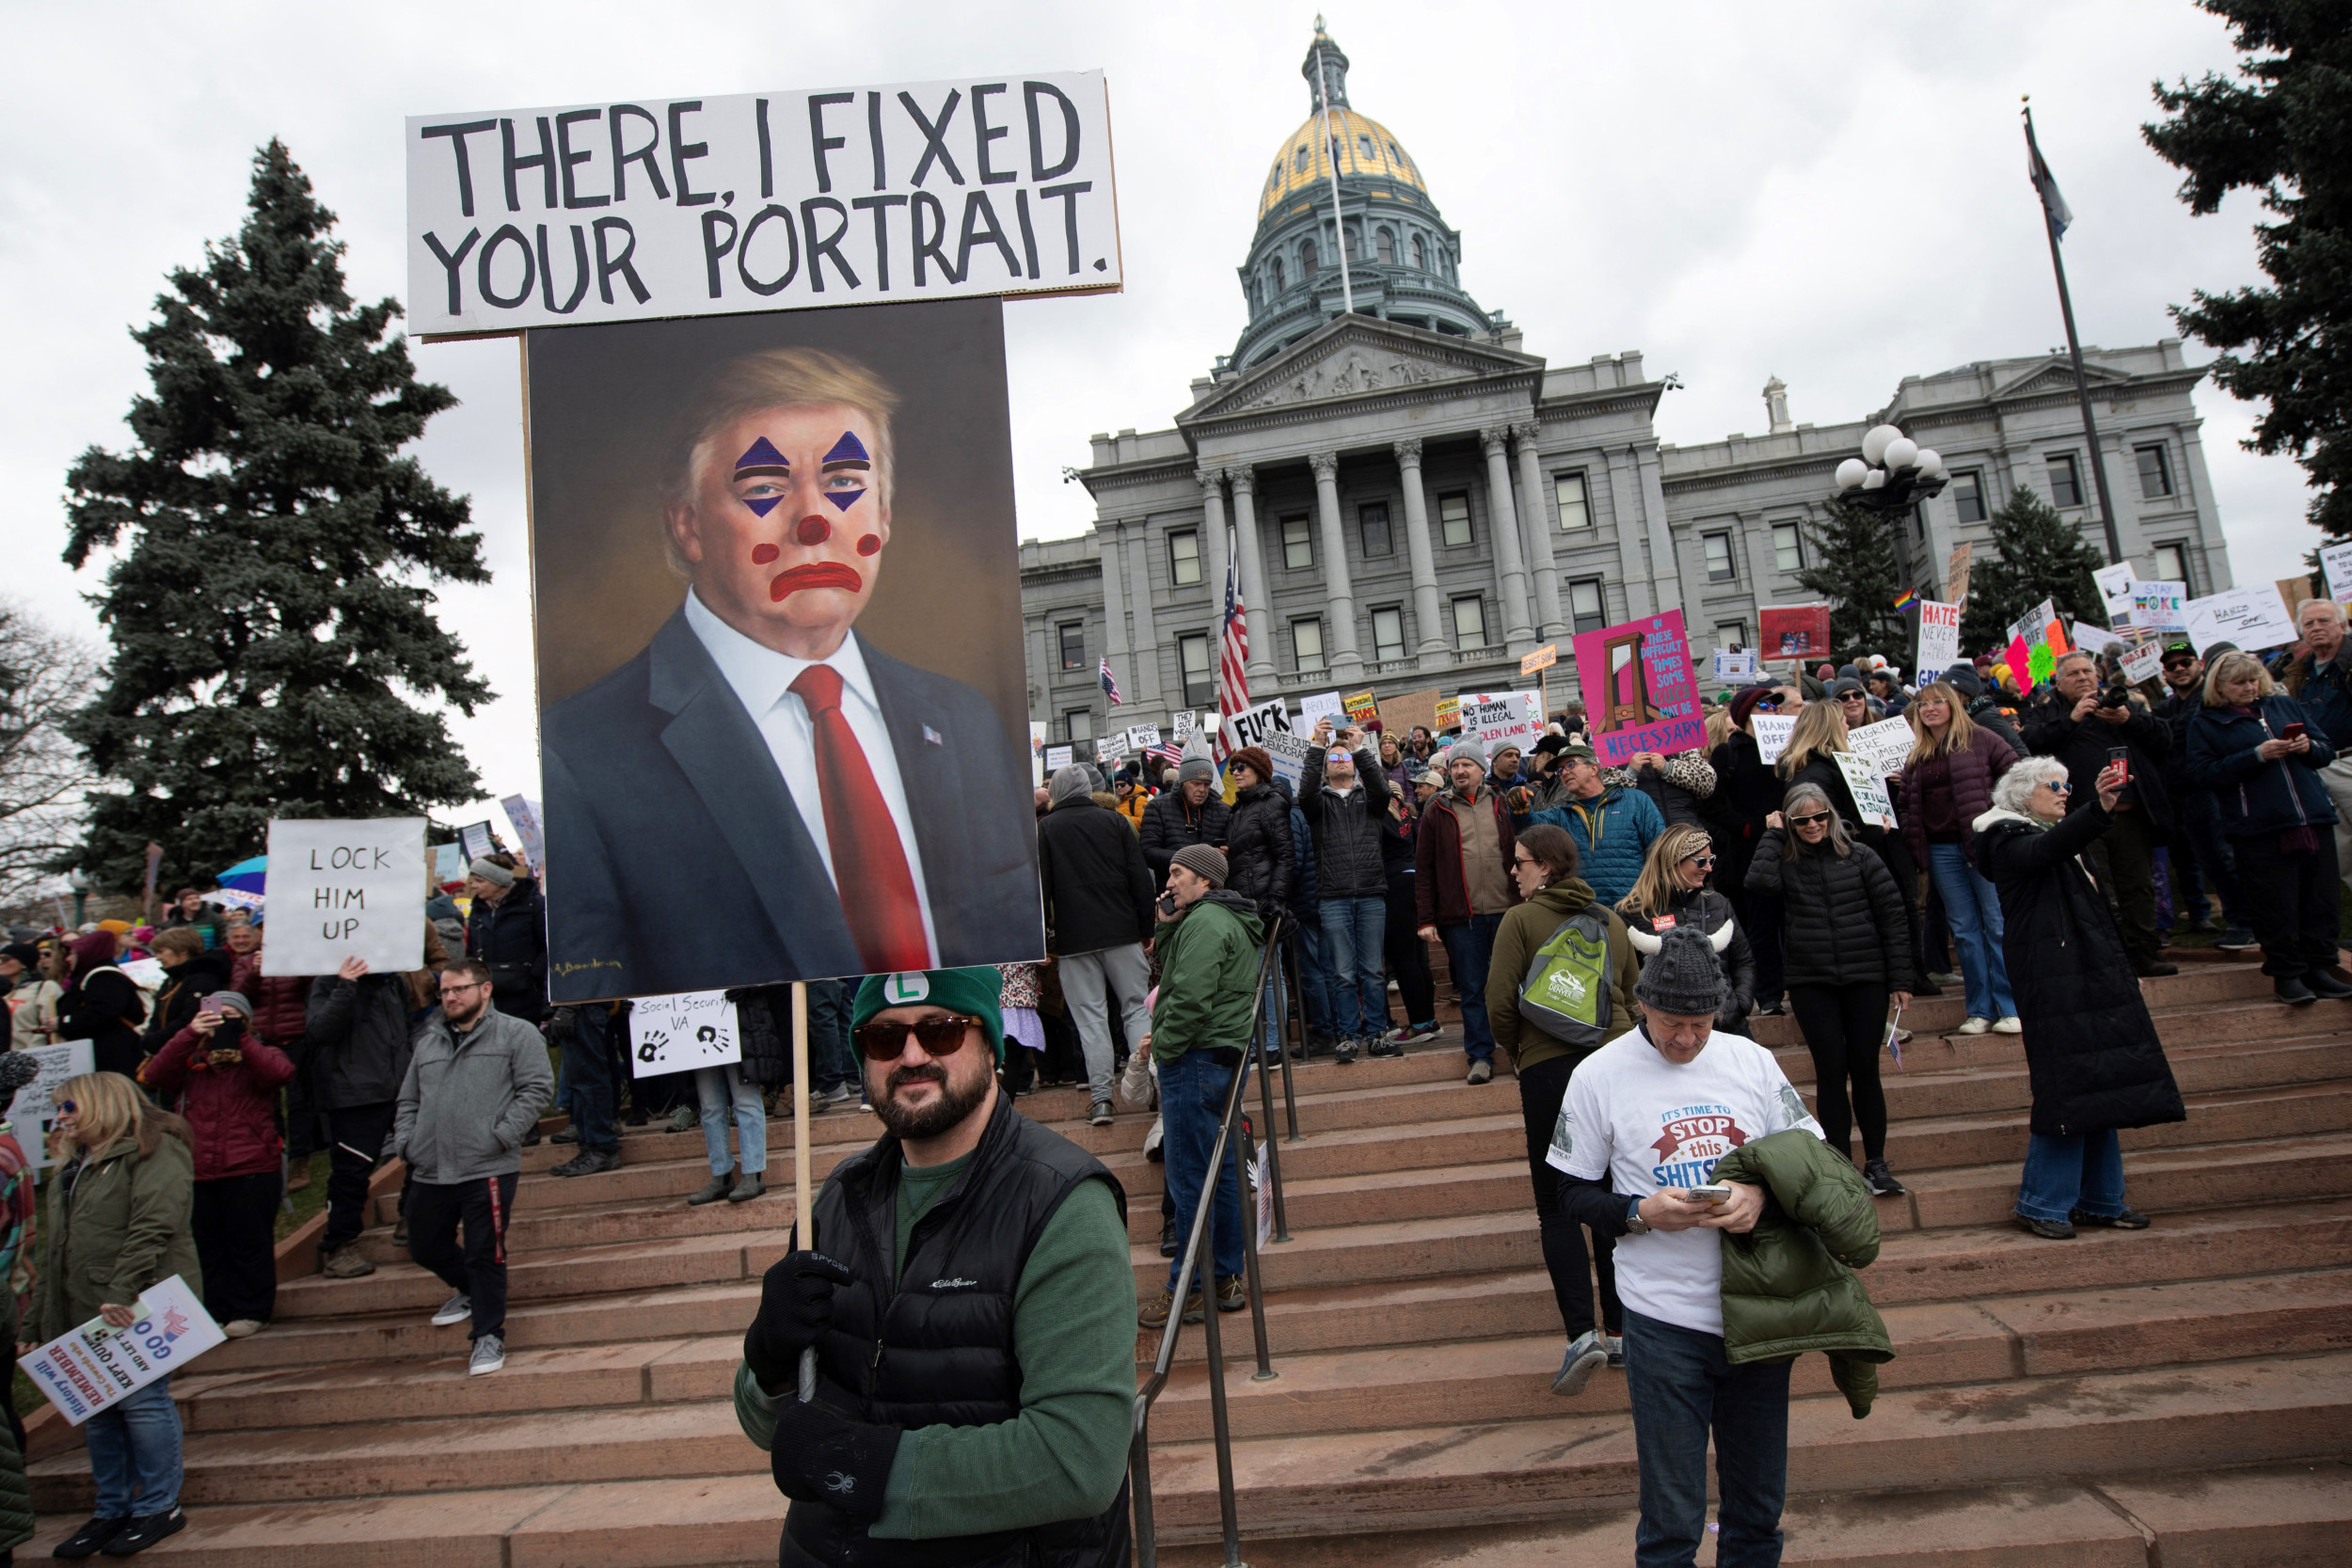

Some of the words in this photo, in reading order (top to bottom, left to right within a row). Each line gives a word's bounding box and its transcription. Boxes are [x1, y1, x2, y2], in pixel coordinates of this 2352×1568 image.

[421, 101, 735, 217] THERE,
[756, 99, 773, 198] I
[808, 81, 1081, 193] FIXED
[421, 215, 652, 316] YOUR
[701, 181, 1107, 298] PORTRAIT.
[2145, 584, 2173, 594] STAY
[1922, 604, 1957, 626] HATE
[2016, 607, 2042, 633] HANDS
[2213, 604, 2249, 621] HANDS
[1653, 618, 1661, 630] IN
[1646, 629, 1673, 645] THESE
[1922, 626, 1956, 641] NEVER
[2026, 627, 2041, 646] OFF
[1641, 640, 1682, 659] DIFFICULT
[1929, 641, 1946, 651] MADE
[1651, 656, 1682, 673] TIMES
[1921, 650, 1954, 661] AMERICA
[1657, 670, 1685, 688] SOME
[1306, 698, 1340, 713] ABOLISH
[1346, 696, 1372, 708] DETHRONE
[1437, 699, 1458, 712] DETHRONE
[1463, 706, 1475, 718] NO
[1479, 700, 1507, 714] HUMAN
[1660, 705, 1679, 720] MAY
[1681, 701, 1692, 715] BE
[1176, 711, 1193, 721] THEY
[1436, 711, 1460, 727] TRUMP
[1470, 717, 1478, 725] IS
[1482, 711, 1515, 724] ILLEGAL
[1136, 721, 1159, 734] HANDS
[1234, 704, 1291, 749] FUCK
[1847, 720, 1906, 743] PILGRIMS
[1137, 734, 1155, 744] OFF
[1266, 729, 1288, 745] SAVE
[1292, 736, 1311, 751] OUR
[1605, 719, 1702, 763] NECESSARY
[1764, 750, 1781, 760] OU
[310, 847, 391, 871] LOCK
[314, 887, 365, 911] HIM
[323, 918, 359, 940] UP
[896, 974, 920, 999] L
[1549, 983, 1573, 999] DENVER
[639, 996, 676, 1015] Social
[683, 994, 729, 1017] Security
[671, 1016, 689, 1030] VA
[1661, 1108, 1680, 1123] IT'S
[1682, 1105, 1713, 1117] TIME
[1714, 1105, 1731, 1115] TO
[1670, 1117, 1730, 1141] STOP
[1689, 1139, 1723, 1158] this
[811, 1252, 850, 1274] SPYDER
[69, 1341, 86, 1358] who
[120, 1339, 138, 1356] LET
[145, 1336, 171, 1360] GO
[34, 1360, 56, 1381] will
[81, 1355, 106, 1386] Cowards
[135, 1355, 151, 1372] AND
[48, 1344, 105, 1407] REMEMBER
[106, 1363, 135, 1389] KEPT
[54, 1378, 88, 1418] History
[103, 1383, 117, 1399] The
